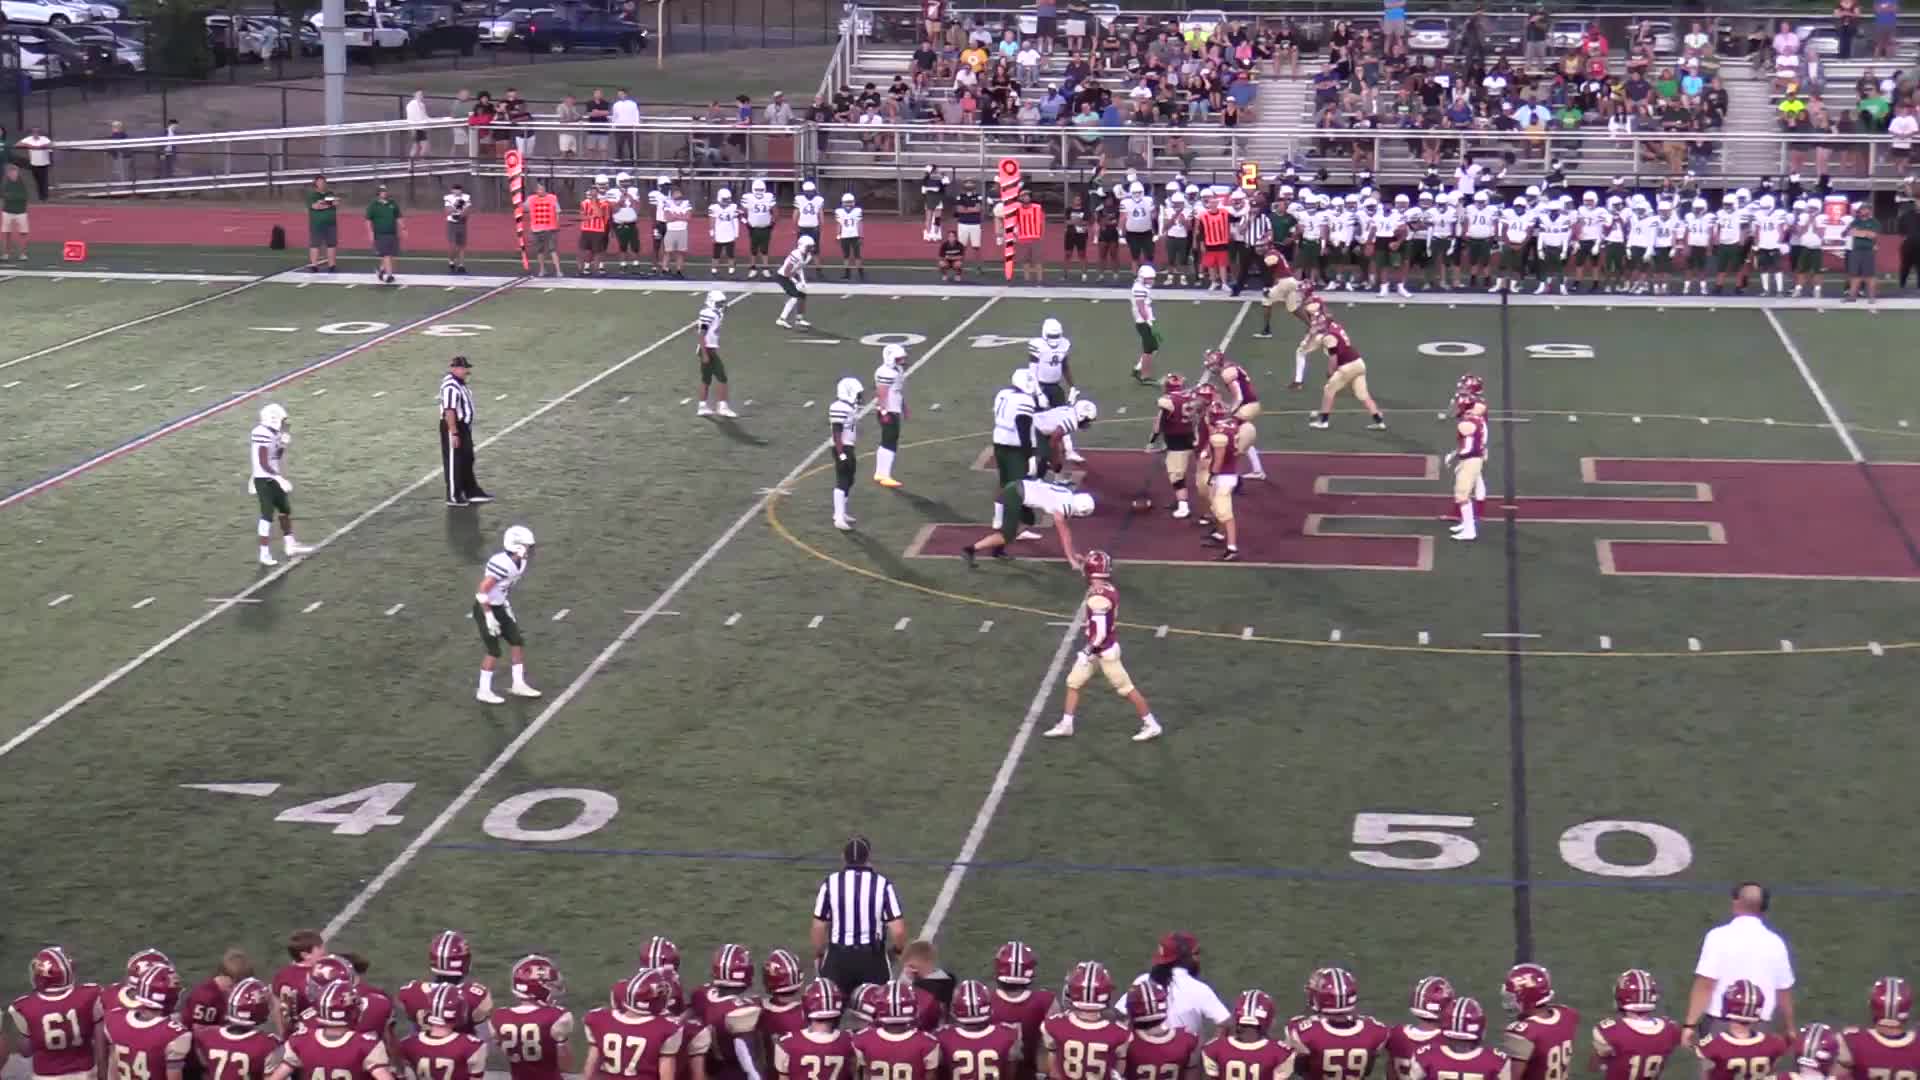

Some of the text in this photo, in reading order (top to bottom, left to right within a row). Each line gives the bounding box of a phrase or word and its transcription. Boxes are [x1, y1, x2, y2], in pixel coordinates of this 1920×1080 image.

[1242, 164, 1257, 189] 2
[42, 1008, 83, 1050] 61
[193, 1004, 217, 1022] 50
[500, 1023, 543, 1062] 28
[600, 1032, 647, 1077] 97
[112, 1044, 151, 1080] 54
[208, 1048, 251, 1080] 73
[416, 1057, 456, 1080] 47
[800, 1055, 845, 1080] 37
[952, 1049, 1000, 1080] 26
[1063, 1039, 1109, 1080] 85
[1322, 1048, 1368, 1080] 59
